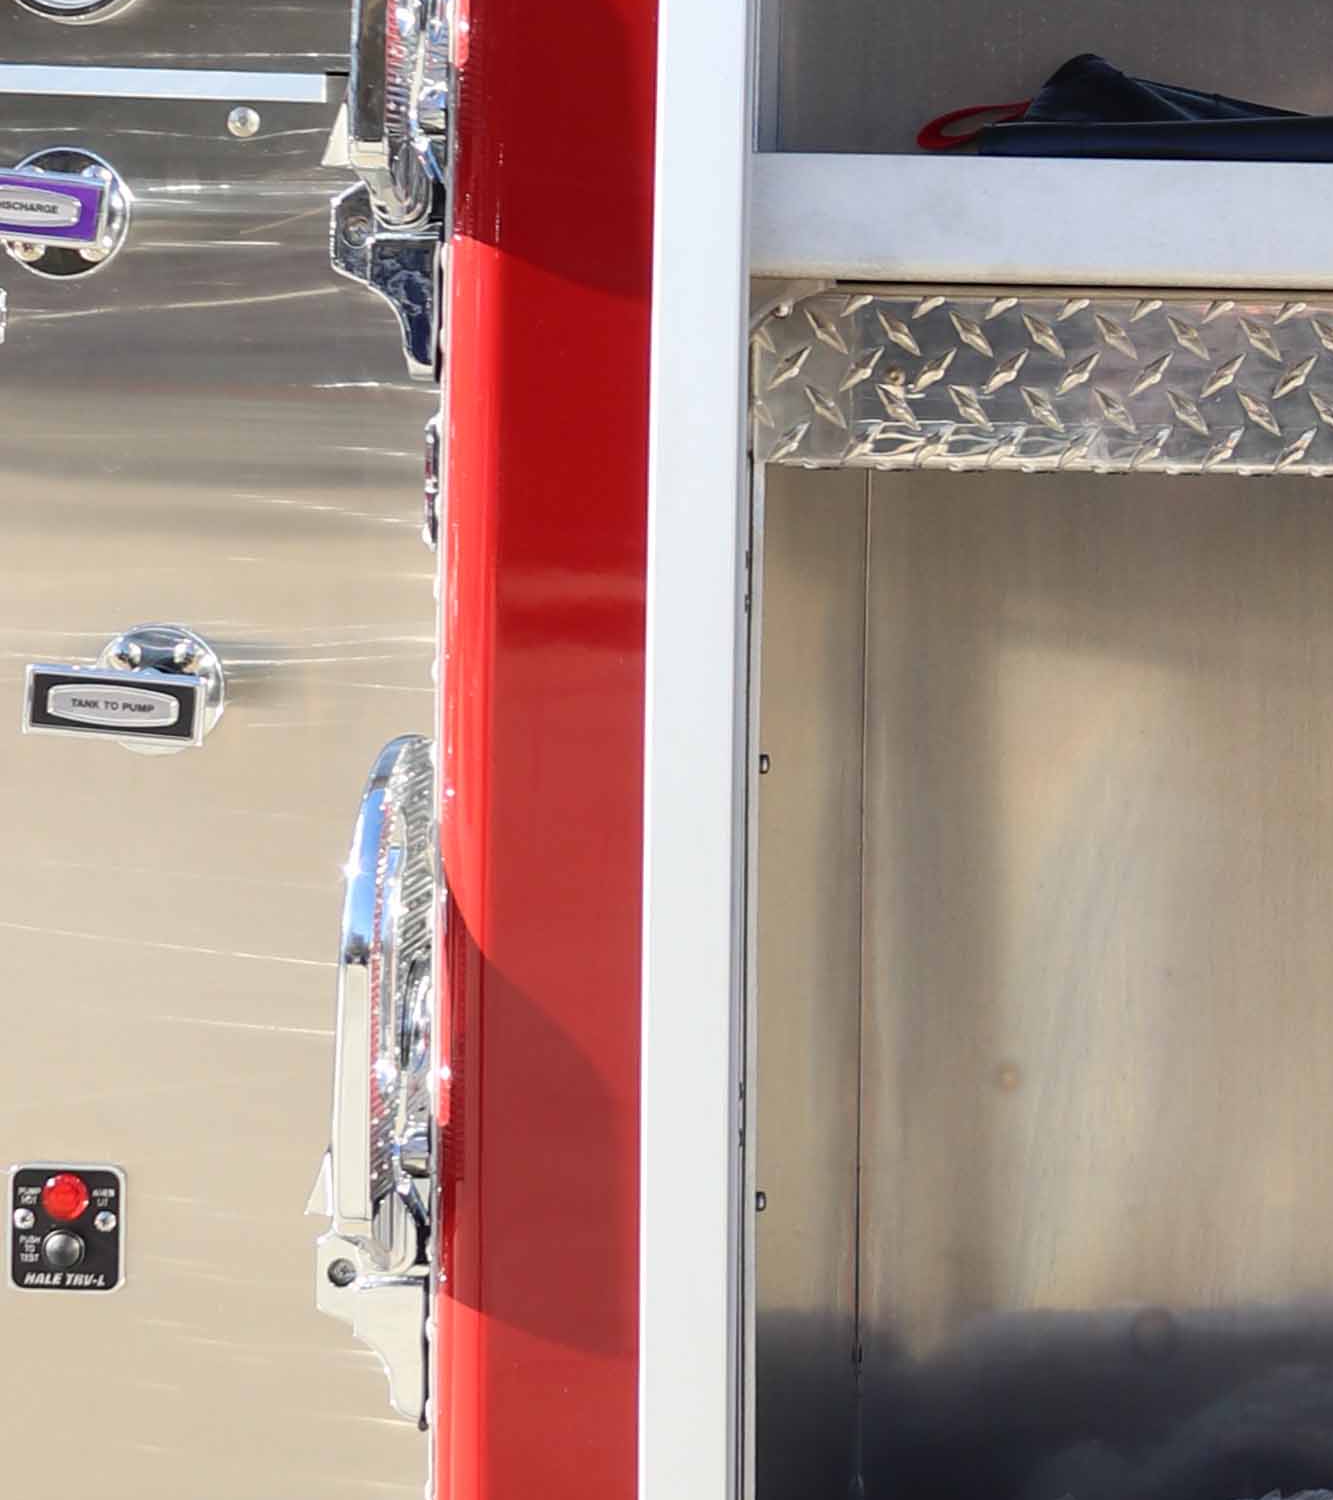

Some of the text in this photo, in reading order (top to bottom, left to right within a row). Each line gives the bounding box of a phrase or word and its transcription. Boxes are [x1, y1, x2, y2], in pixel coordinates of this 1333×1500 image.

[71, 698, 155, 713] TANK TO PUMP
[23, 1272, 63, 1285] HALE
